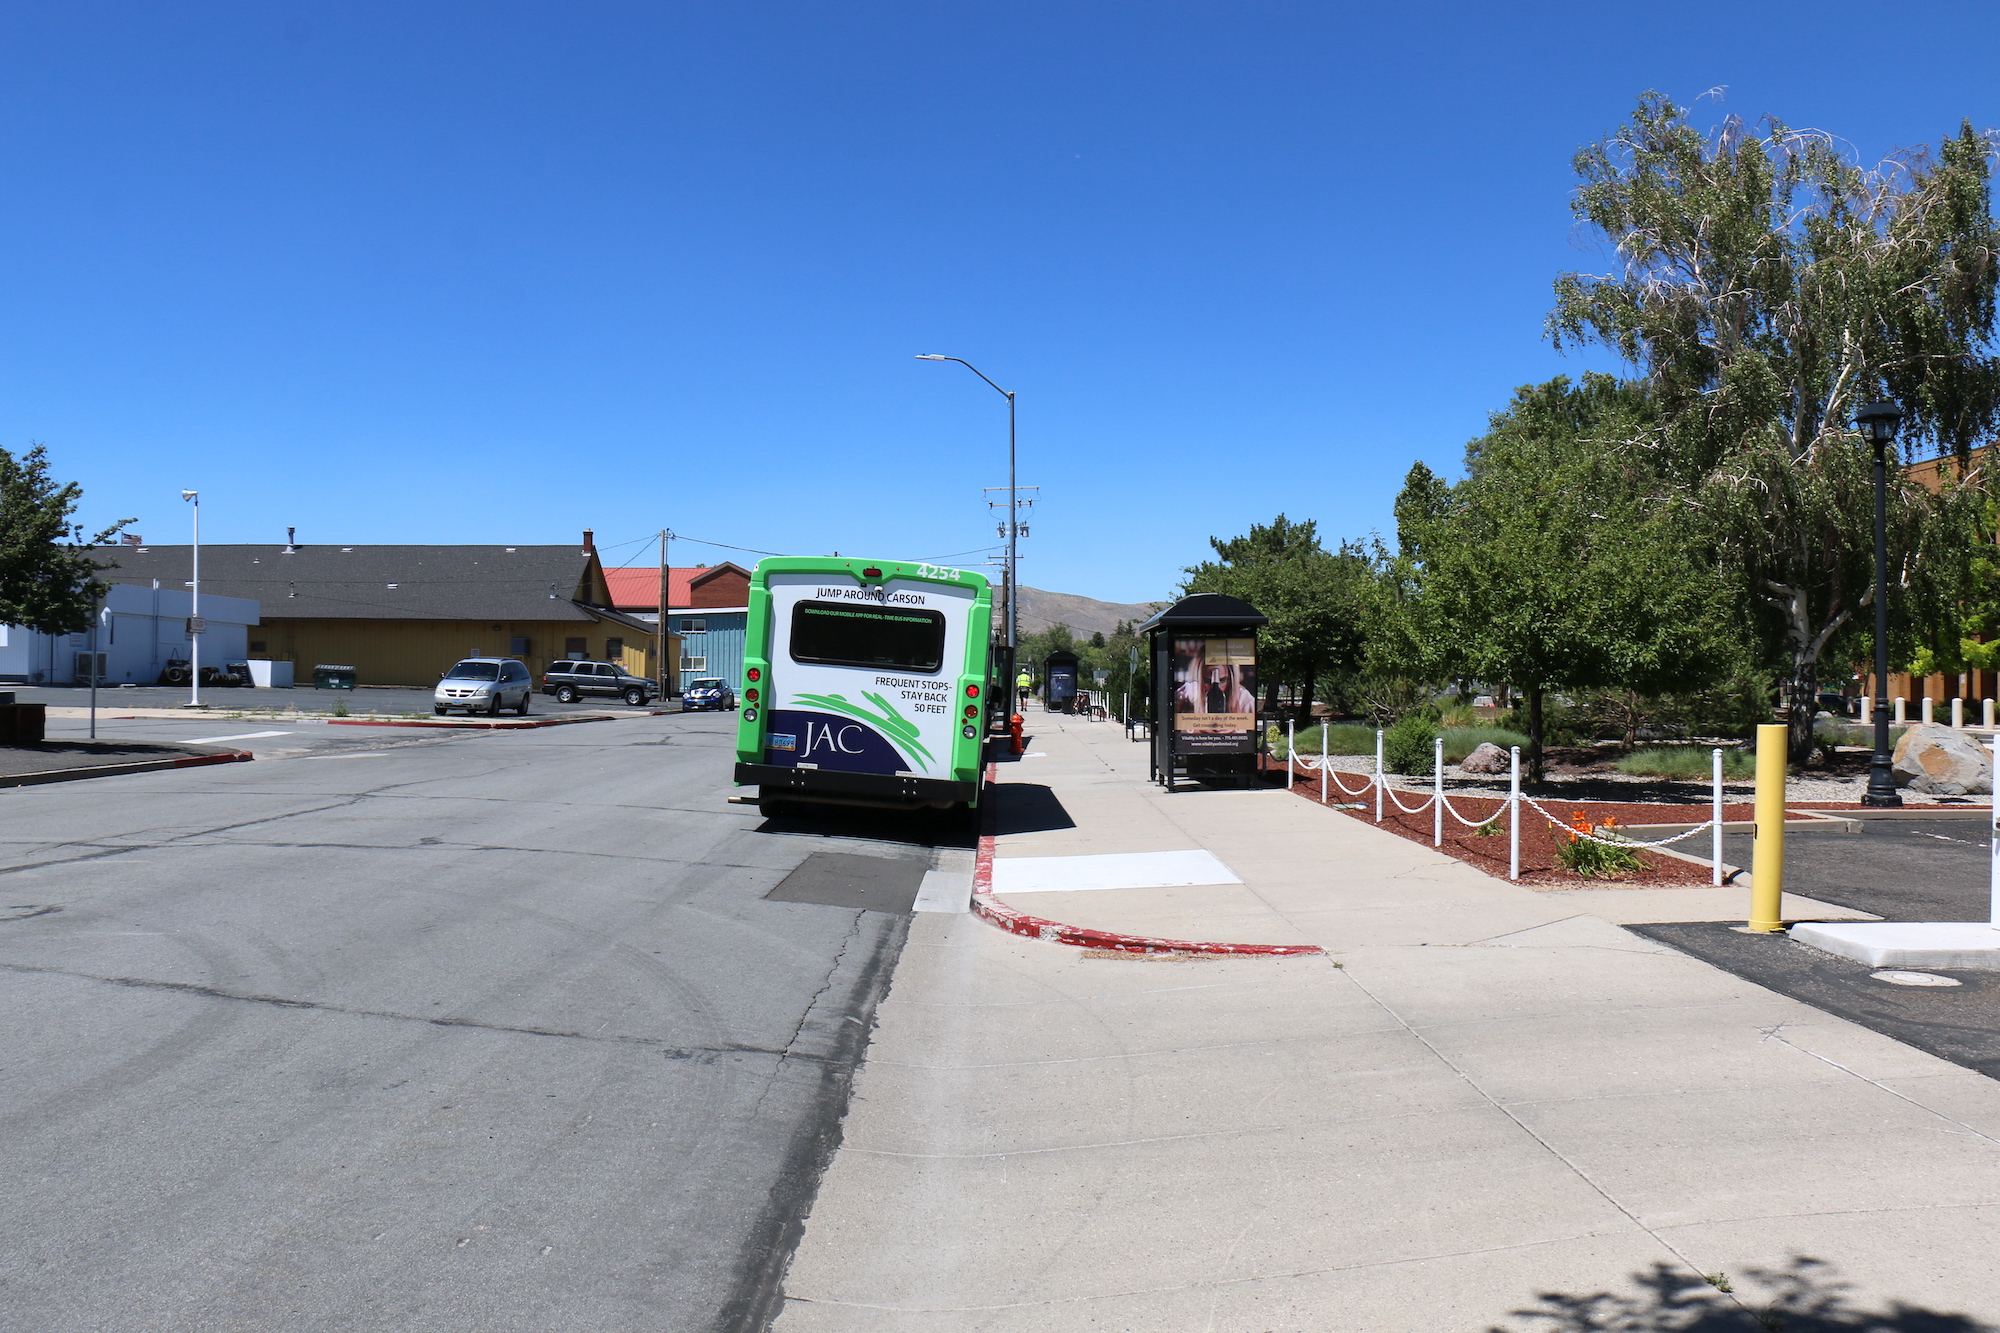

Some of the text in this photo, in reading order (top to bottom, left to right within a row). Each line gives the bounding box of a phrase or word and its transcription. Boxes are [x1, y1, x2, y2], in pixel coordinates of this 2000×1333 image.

[916, 564, 960, 580] 4254
[816, 587, 925, 605] JUMP AROUND CARSON
[903, 616, 932, 624] INFORMATION
[875, 676, 952, 691] FREQUENT STOPS-
[901, 690, 947, 702] STAY BACK
[914, 703, 947, 714] 50 FEET
[800, 721, 864, 758] JAC
